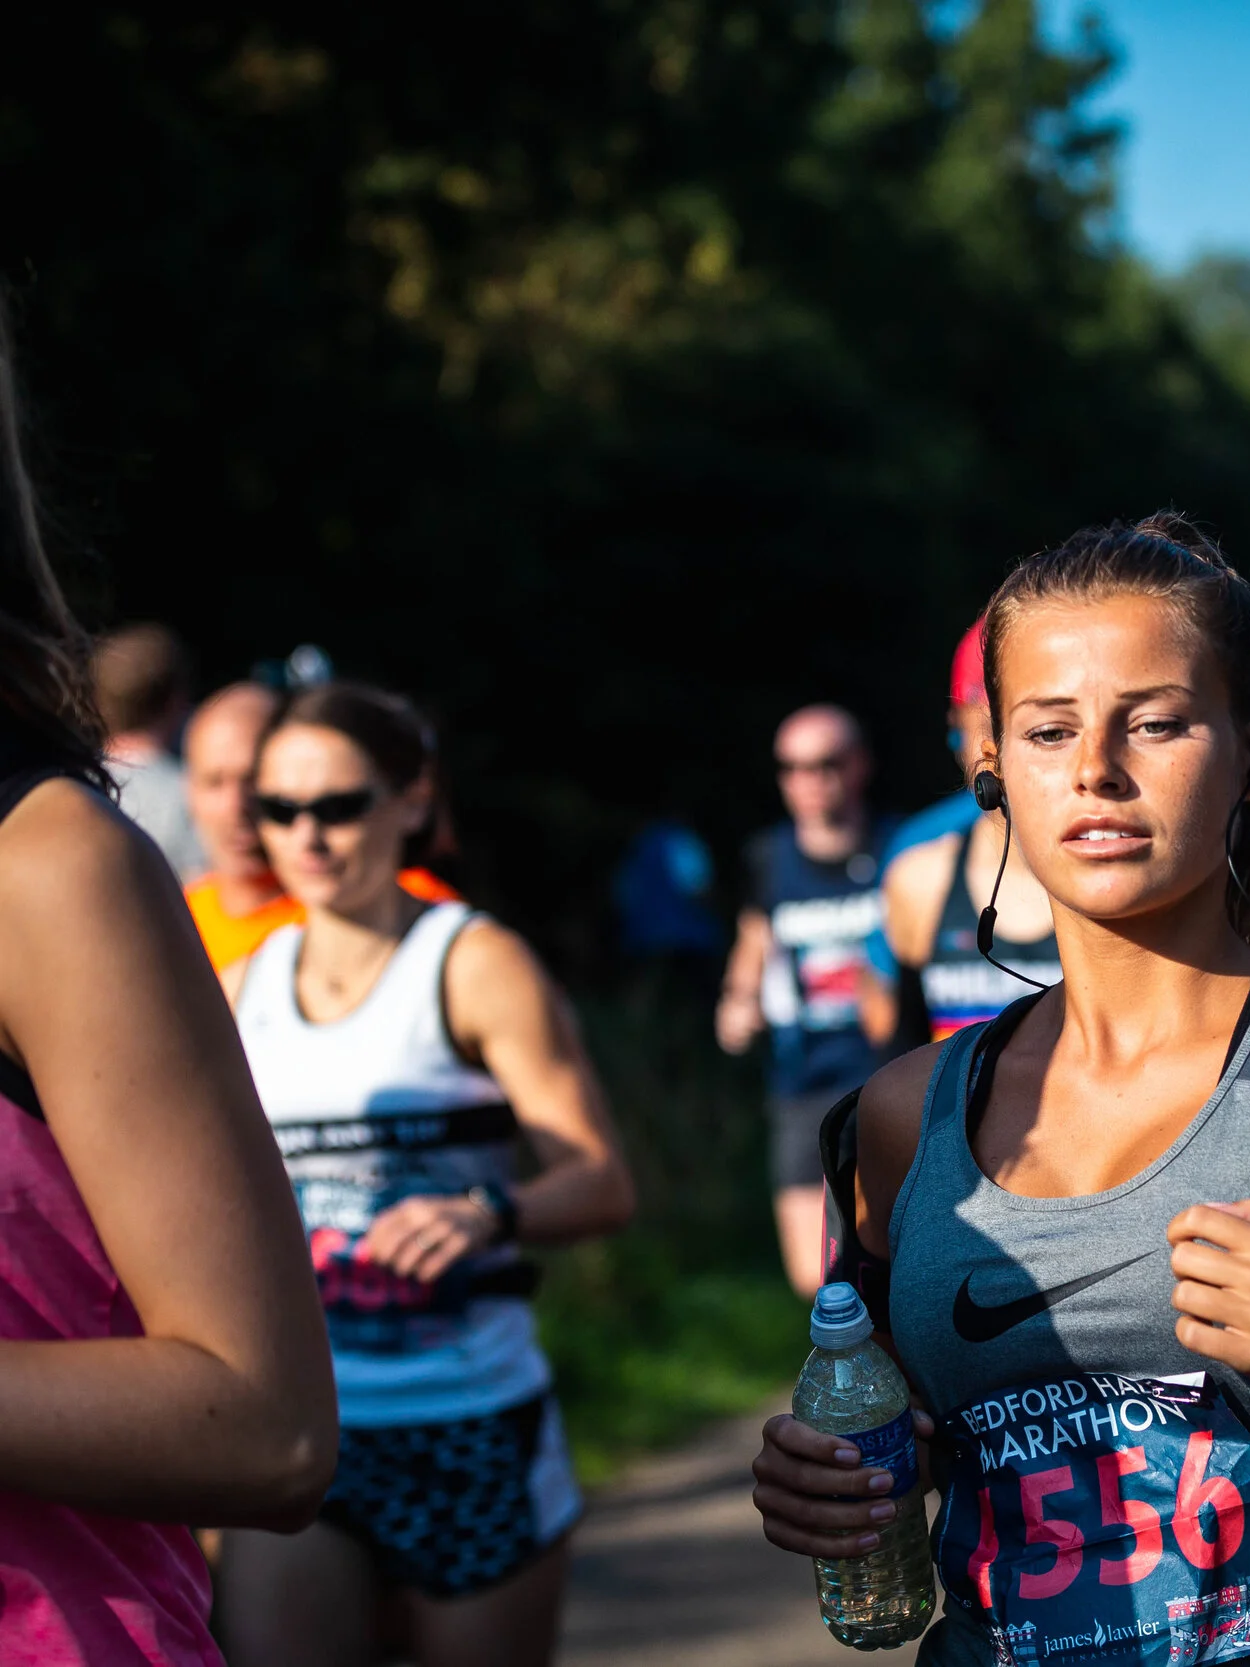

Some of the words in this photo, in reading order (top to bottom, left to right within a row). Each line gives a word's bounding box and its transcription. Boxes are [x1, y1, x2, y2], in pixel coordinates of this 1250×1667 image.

[961, 1379, 1087, 1435] BEDFORD
[1091, 1376, 1160, 1397] HAL
[980, 1397, 1187, 1474] MARATHON
[1043, 1631, 1093, 1658] james
[1107, 1619, 1160, 1642] lawler
